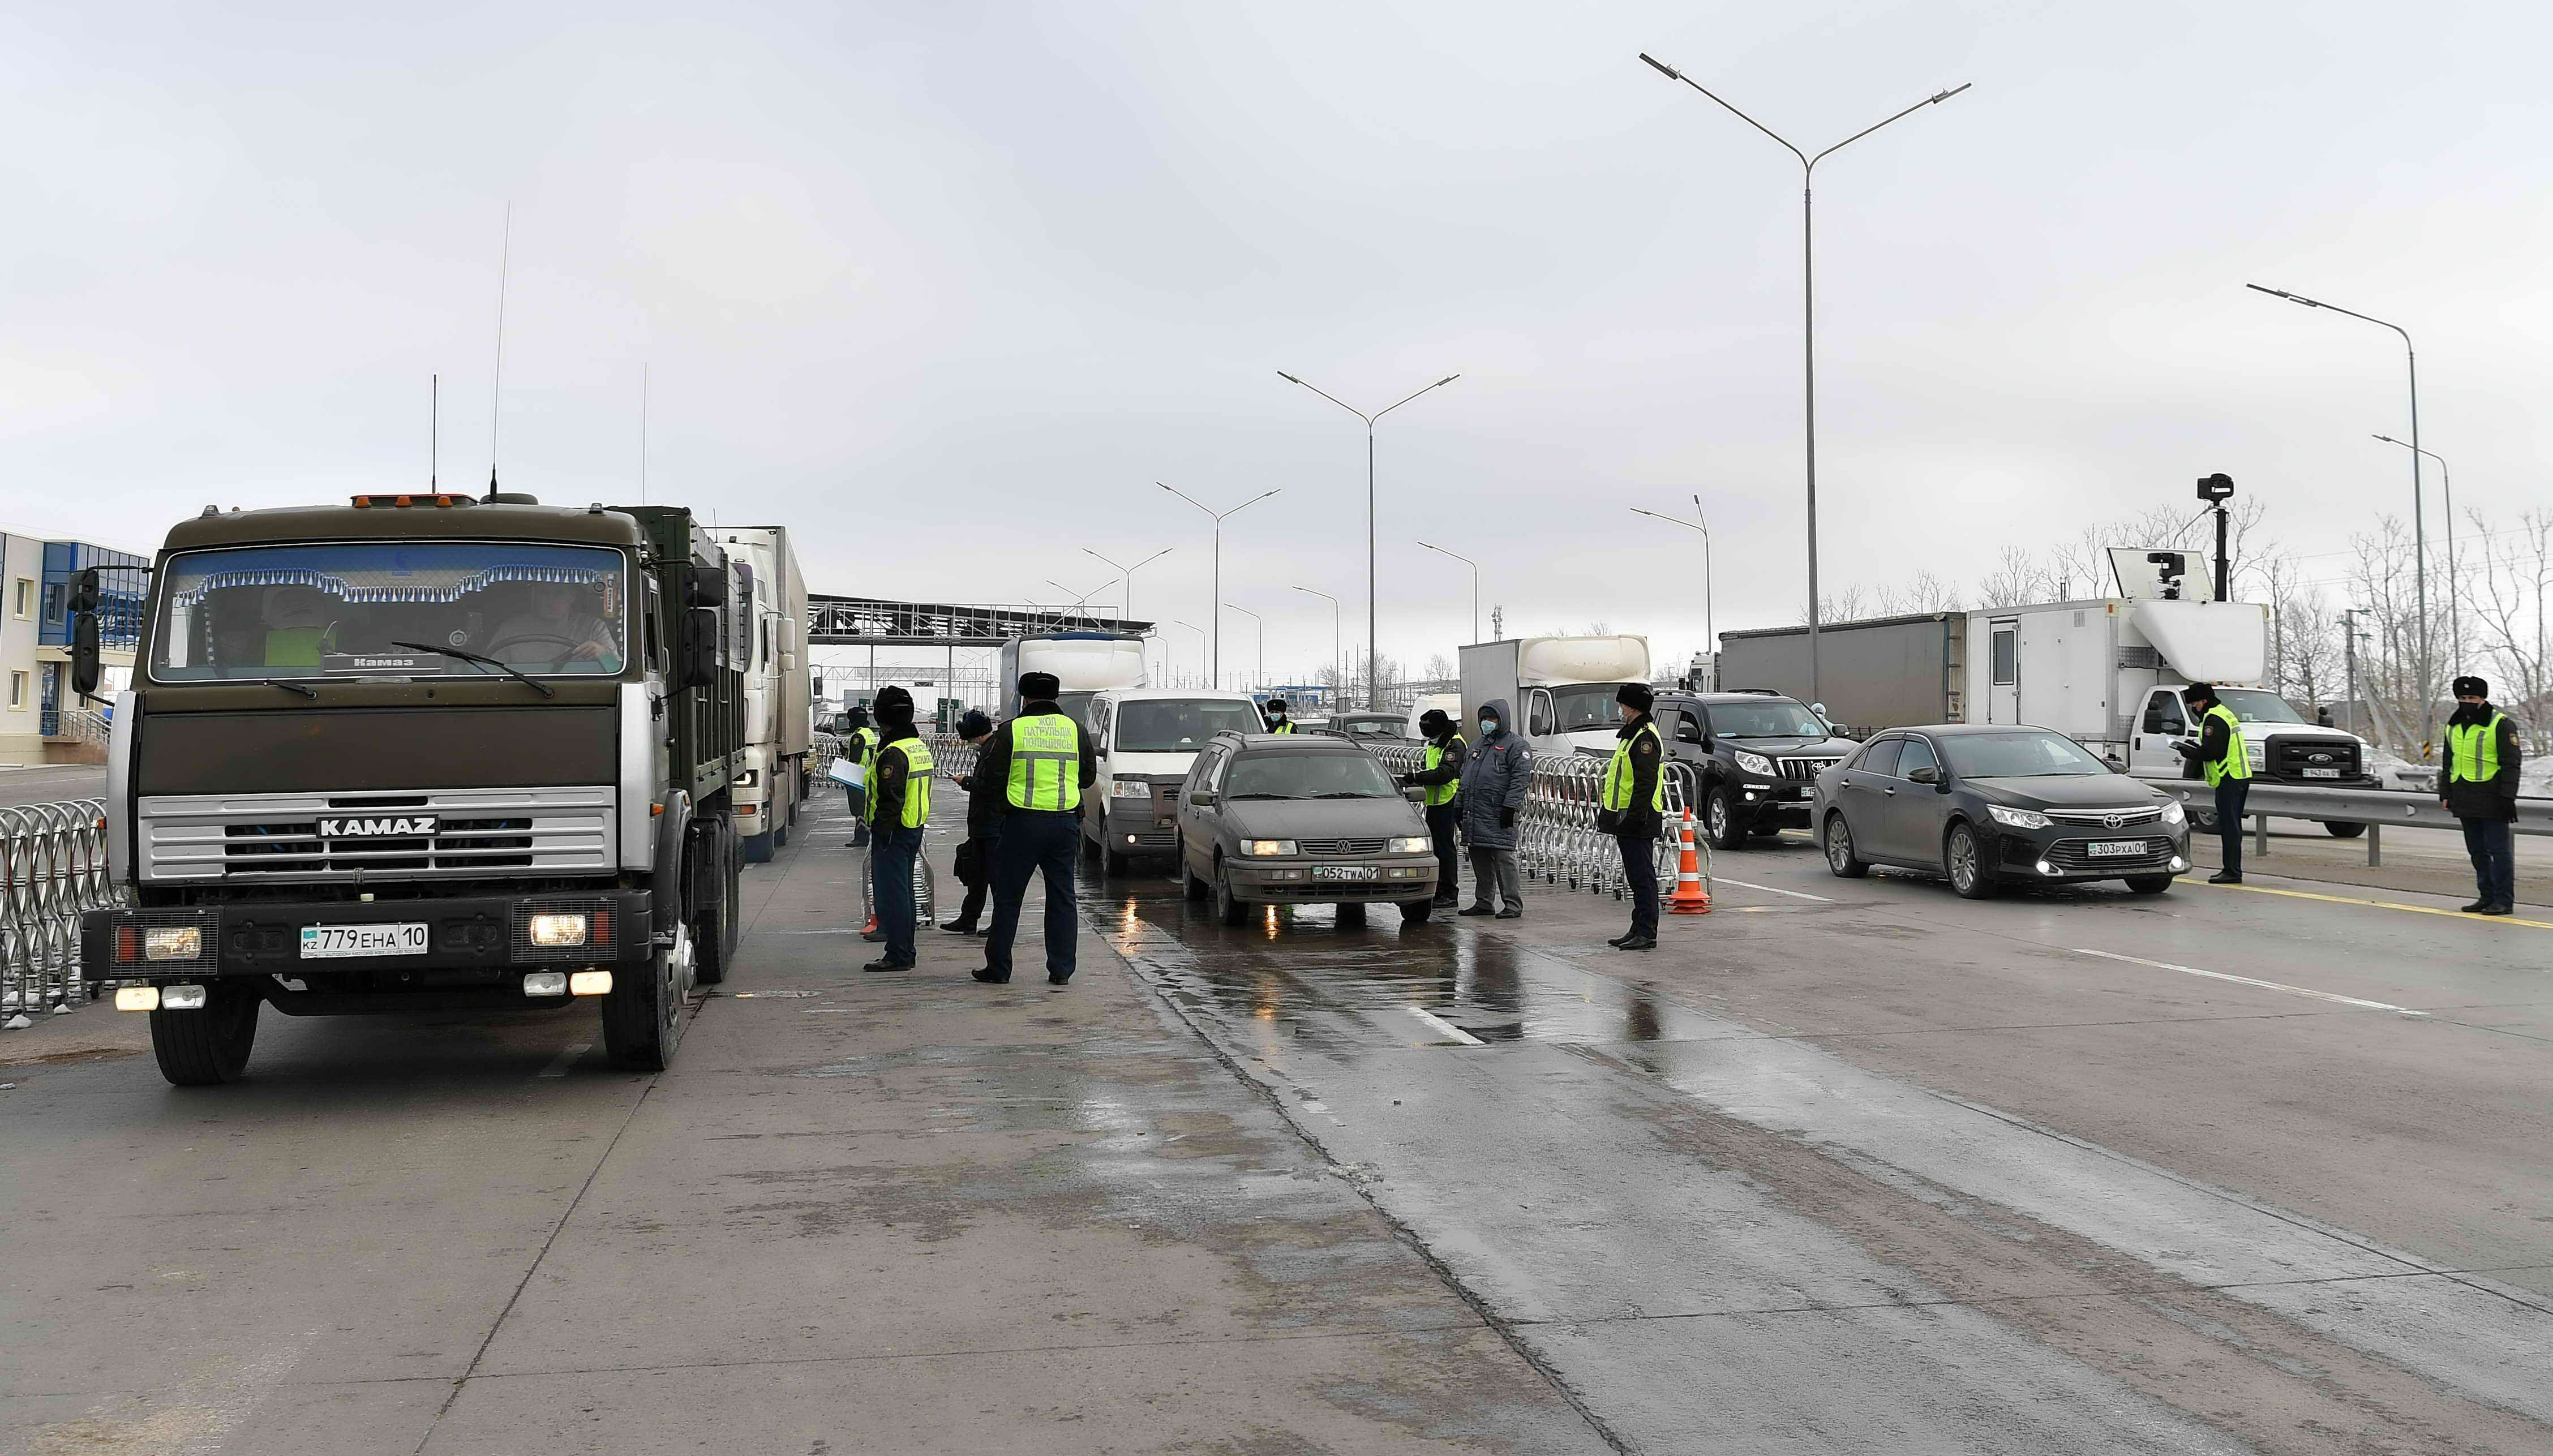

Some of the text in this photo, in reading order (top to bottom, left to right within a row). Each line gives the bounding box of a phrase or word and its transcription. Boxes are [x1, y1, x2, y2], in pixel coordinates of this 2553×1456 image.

[1038, 717, 1056, 726] ЖОЛ
[1023, 737, 1073, 750] ПОЛИЦИЯСЫ
[321, 818, 435, 836] KAMAZ
[2135, 843, 2146, 853] 01
[1366, 868, 1379, 879] 01
[402, 927, 425, 946] 10
